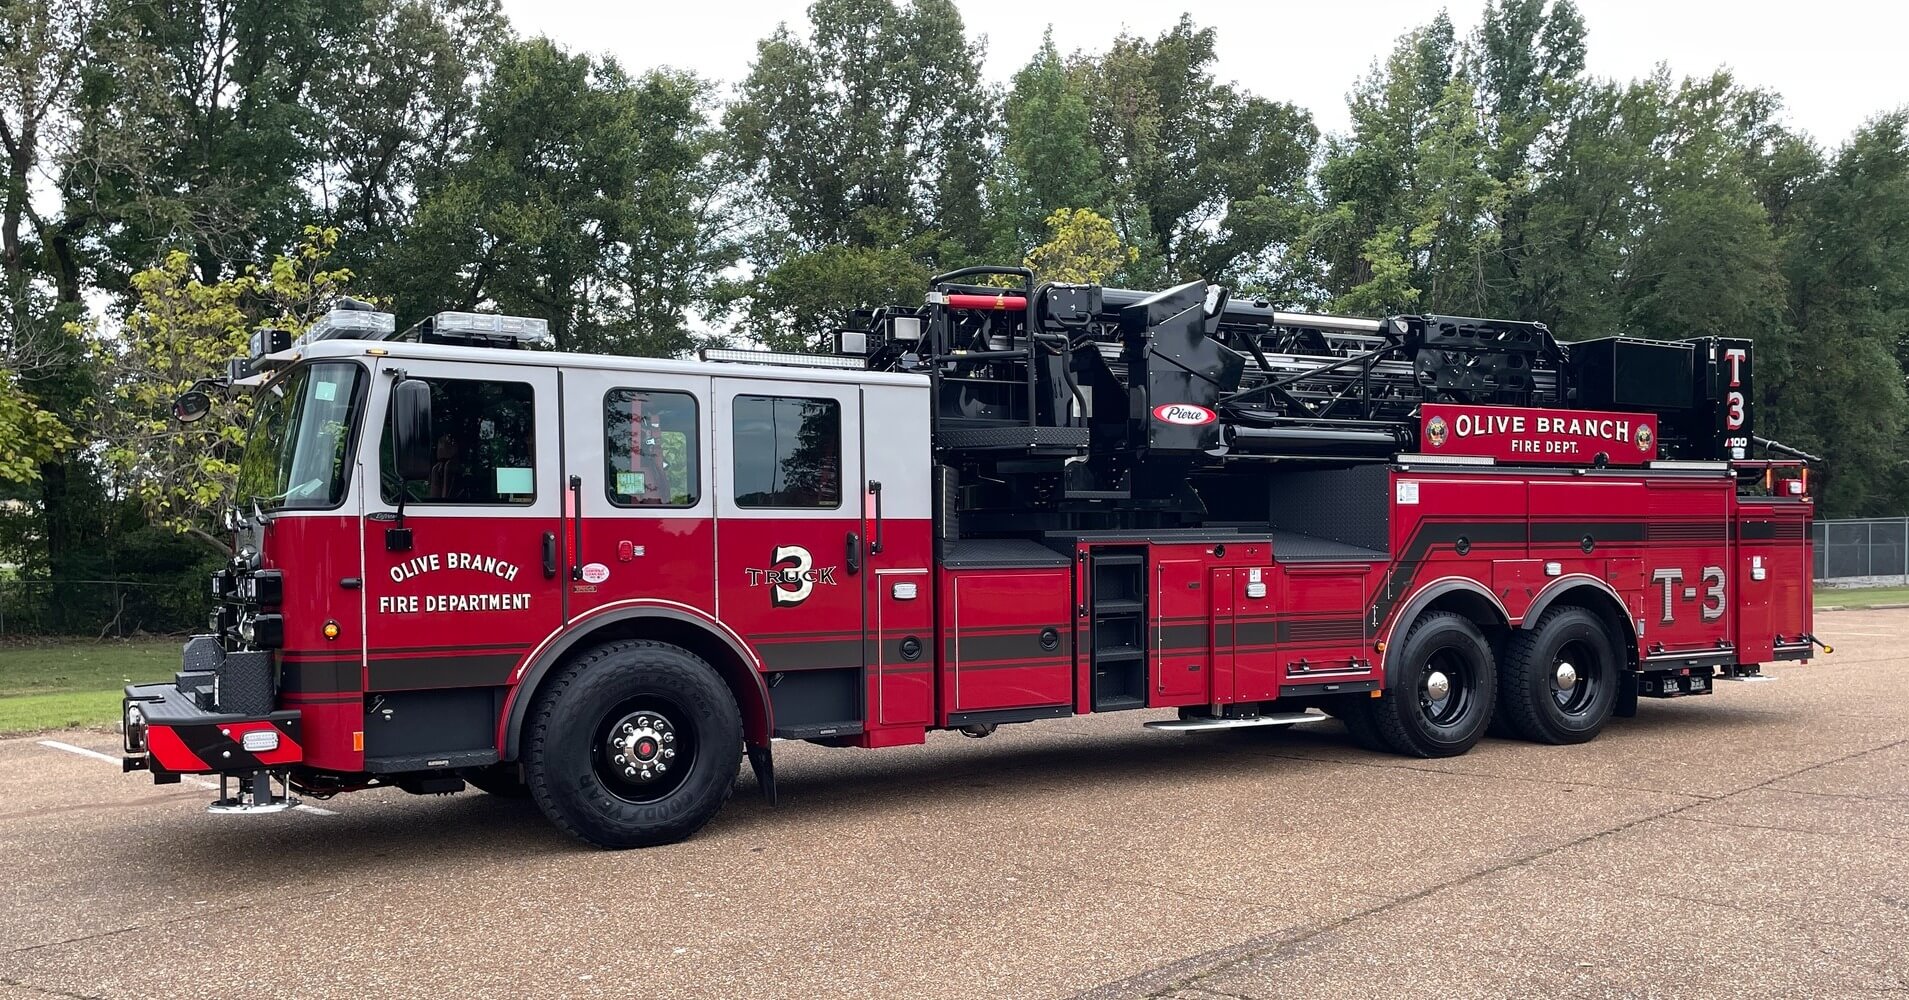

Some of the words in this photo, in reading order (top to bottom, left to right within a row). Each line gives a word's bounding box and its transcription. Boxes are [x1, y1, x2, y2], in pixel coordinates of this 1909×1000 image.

[1167, 406, 1202, 420] Pierce
[1455, 414, 1526, 437] OLIVE
[1537, 417, 1630, 443] BRANCH
[1511, 439, 1540, 453] FIRE
[1545, 440, 1579, 454] DEPT.
[390, 554, 441, 583] OLIVE
[447, 552, 519, 582] BRANCH
[745, 565, 837, 587] TRUCK
[771, 545, 813, 607] 3
[379, 596, 419, 613] FIRE
[425, 593, 532, 612] DEPARTMENT
[1651, 566, 1726, 623] T-3
